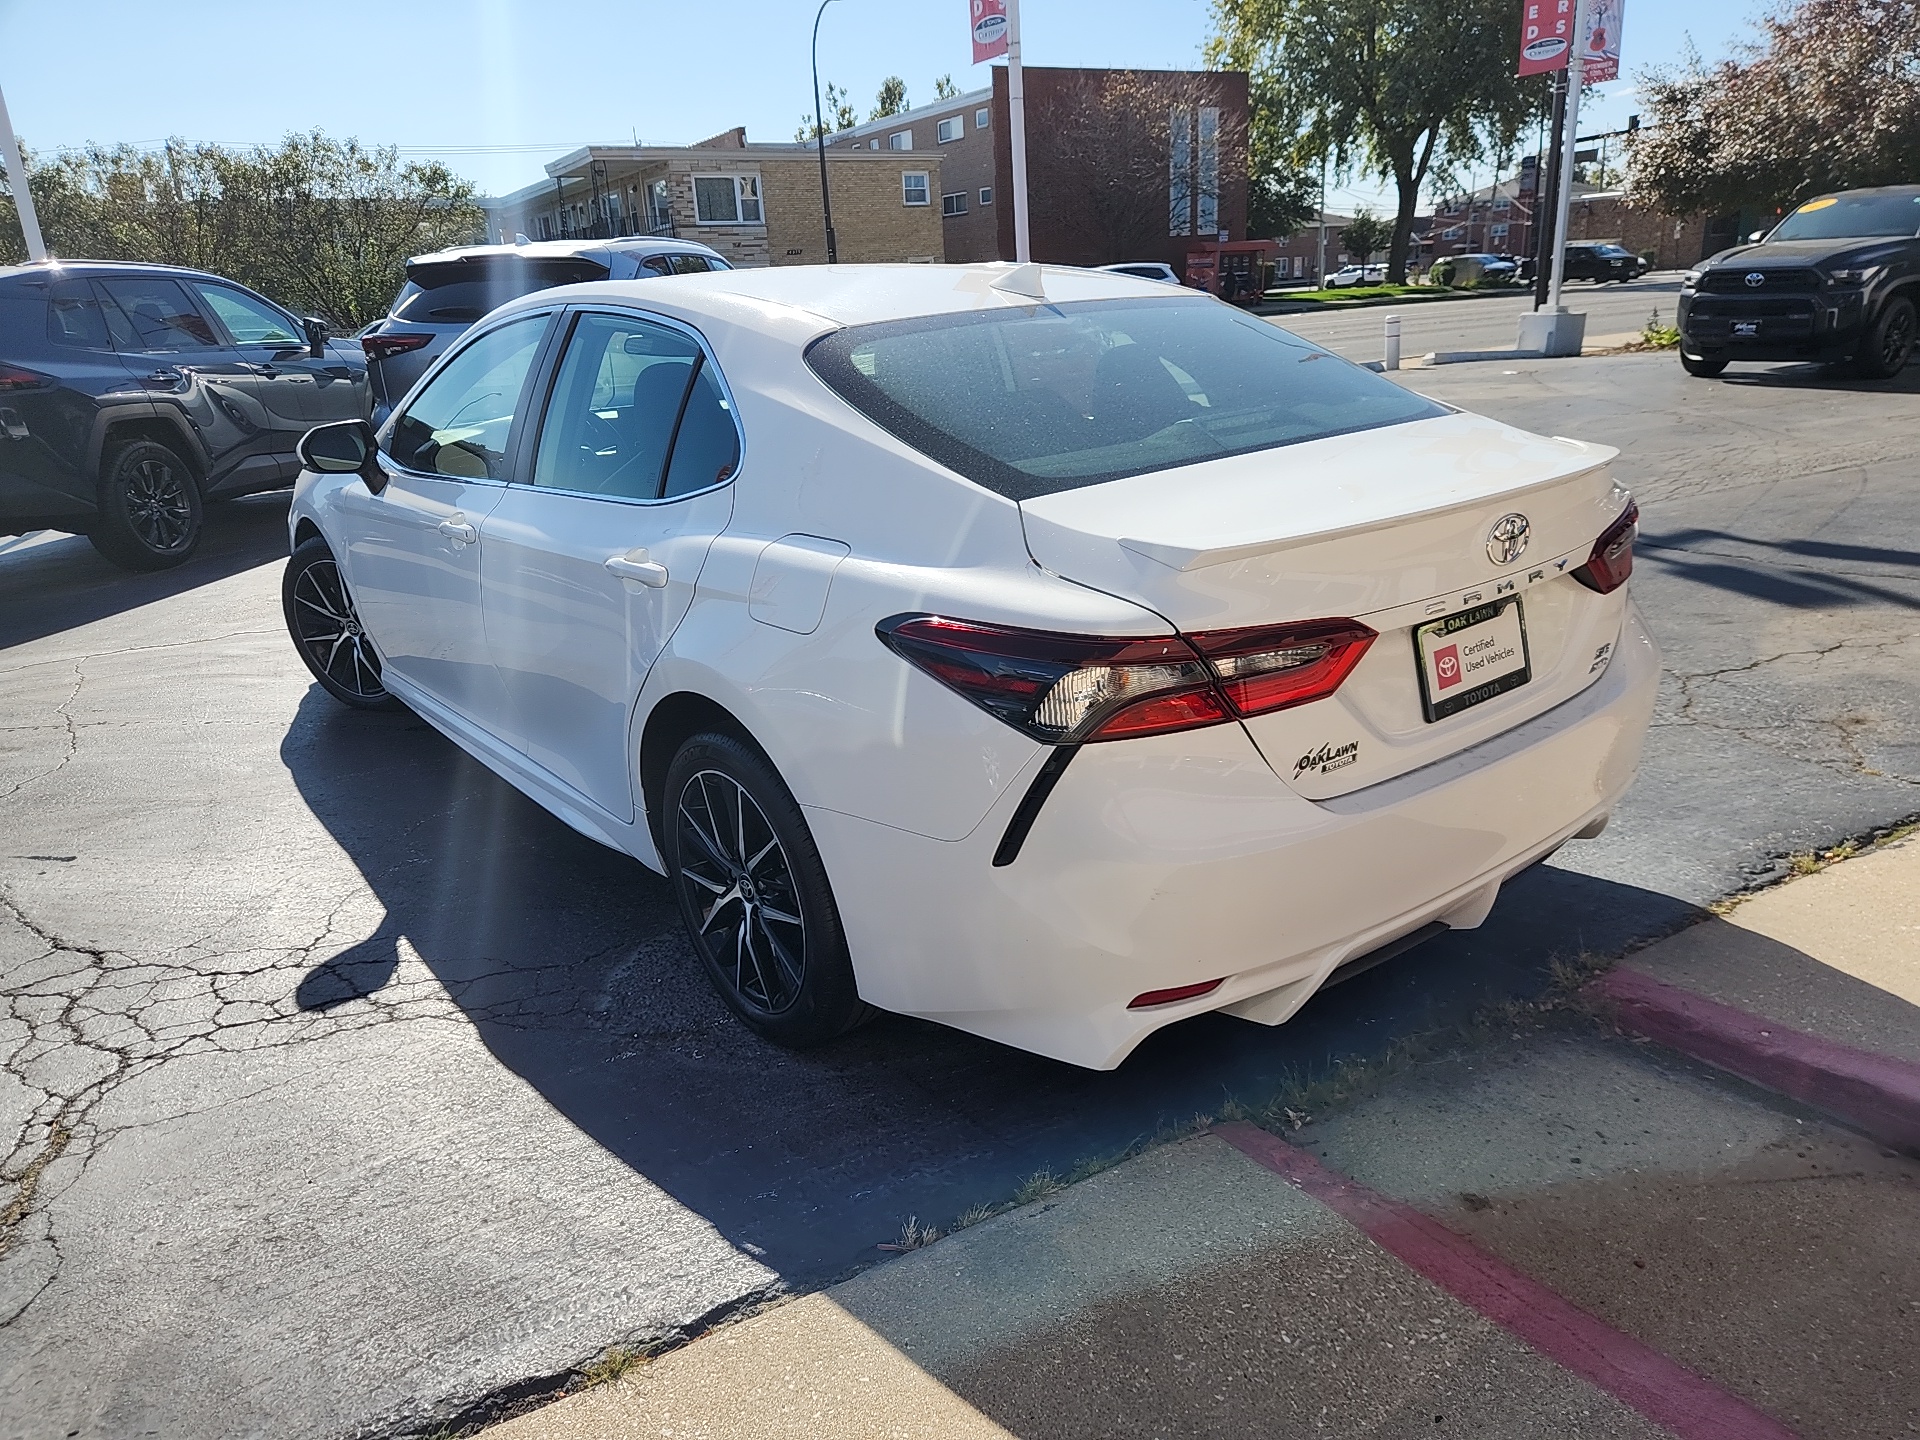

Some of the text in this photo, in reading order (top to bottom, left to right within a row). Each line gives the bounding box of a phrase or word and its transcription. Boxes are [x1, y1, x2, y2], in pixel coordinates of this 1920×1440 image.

[1425, 558, 1569, 616] CAMRY
[1447, 605, 1494, 631] OAK LAWN
[1462, 635, 1495, 657] Certified
[1465, 646, 1515, 673] Used Vehicles
[1463, 683, 1502, 706] TOYOTA
[1324, 757, 1351, 772] TOYOTA
